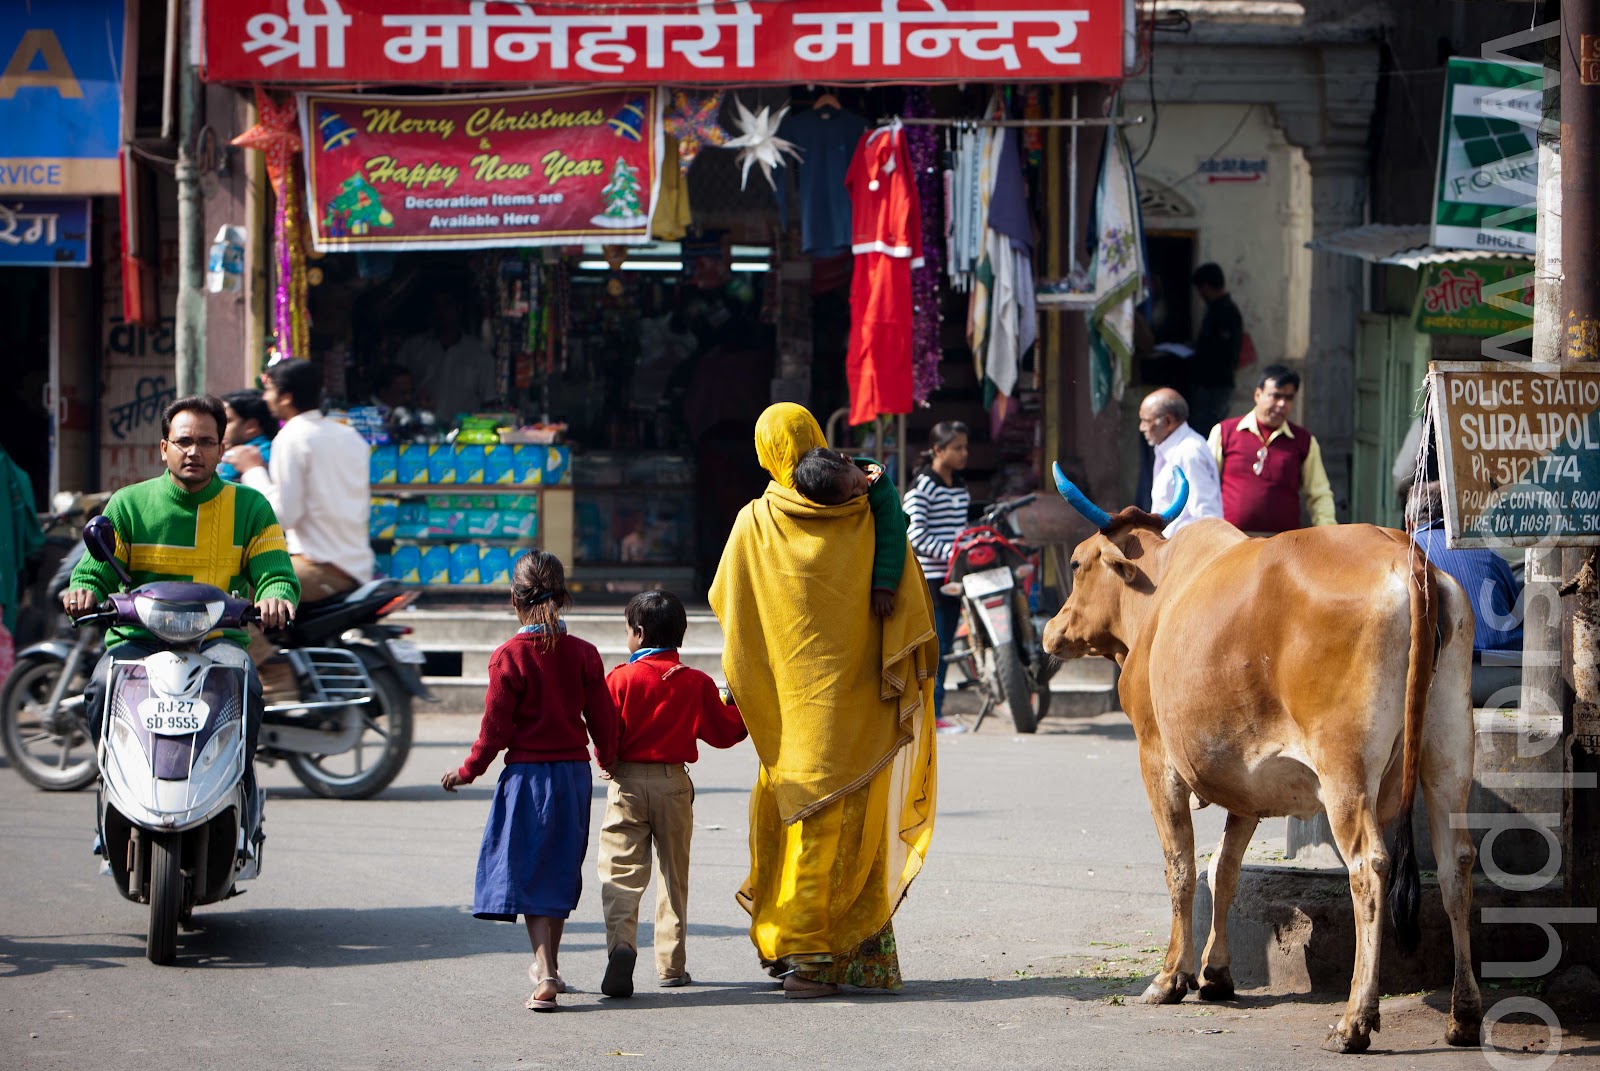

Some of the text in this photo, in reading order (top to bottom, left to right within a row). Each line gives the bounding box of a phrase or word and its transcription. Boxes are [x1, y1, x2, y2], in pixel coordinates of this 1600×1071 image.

[242, 0, 1090, 73] श्री मनिहारी मन्दिर
[362, 107, 606, 140] Merry Christmas
[479, 137, 491, 150] &
[365, 149, 605, 189] Happy New Year
[1451, 160, 1535, 198] FOUR
[405, 193, 564, 210] Decoration Items are
[429, 212, 541, 228] Available Here
[1476, 232, 1526, 248] BHOLE
[1424, 268, 1484, 312] भोले
[1451, 378, 1600, 406] POLICE STATIO
[1459, 412, 1600, 450] SURAJPOL
[1496, 454, 1582, 485] 5121774
[1461, 489, 1508, 510] POLICE
[1509, 490, 1568, 510] CONTROL
